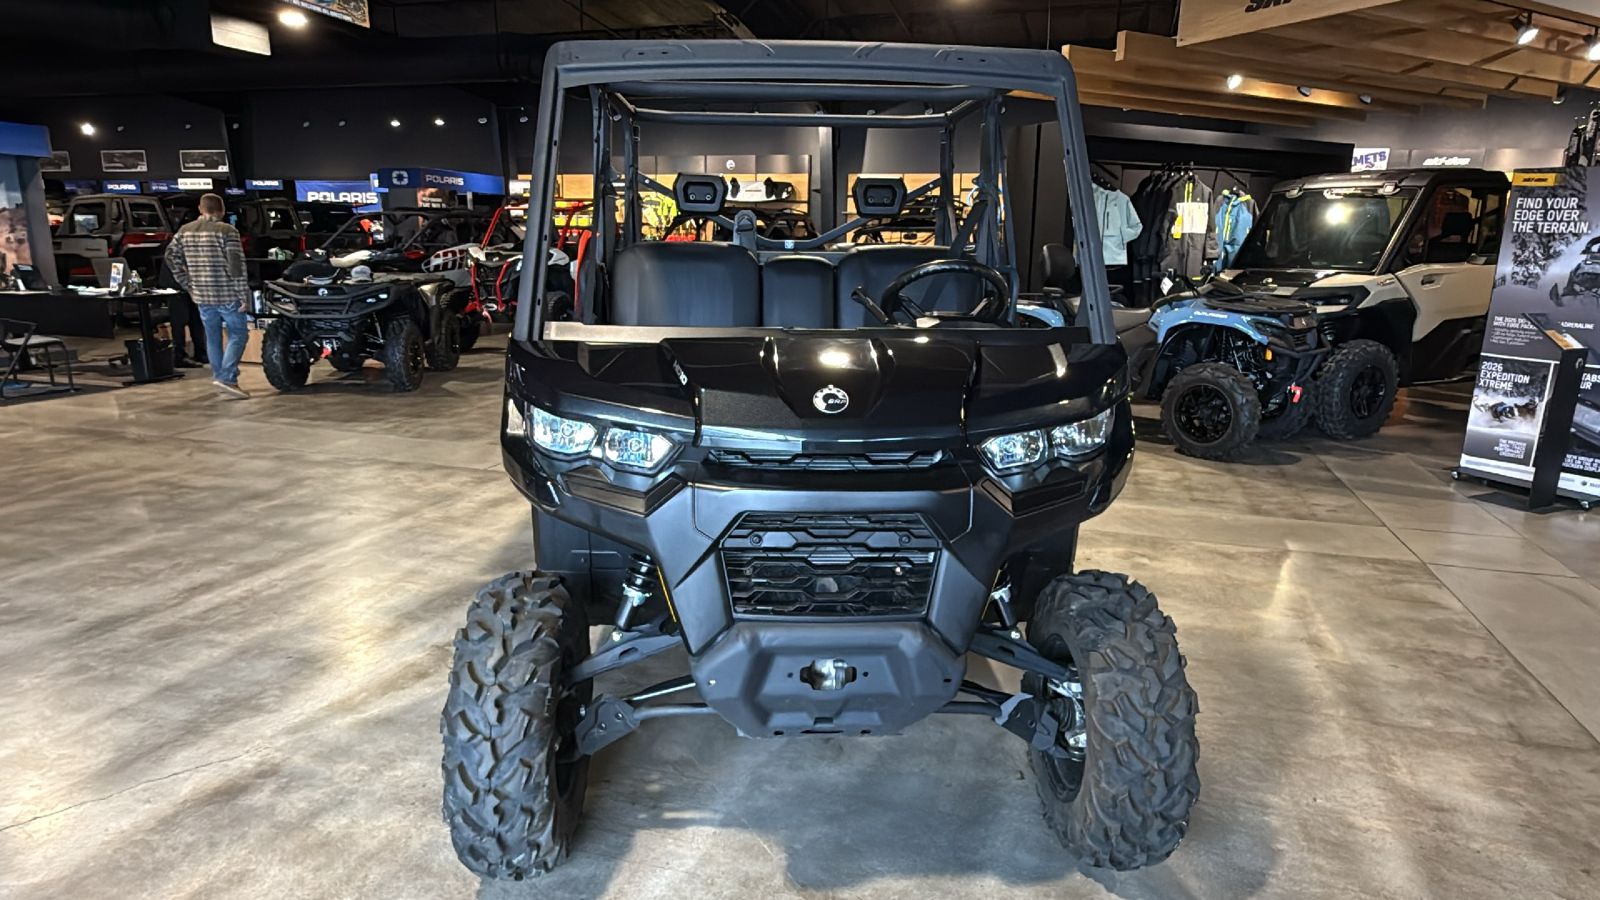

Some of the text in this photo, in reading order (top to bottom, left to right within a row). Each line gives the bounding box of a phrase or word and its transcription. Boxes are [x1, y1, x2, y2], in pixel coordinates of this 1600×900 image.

[1352, 151, 1387, 166] METS
[425, 174, 465, 186] POLARIS
[307, 191, 378, 204] POLARIS
[1516, 197, 1579, 209] FIND YOUR
[1514, 209, 1580, 221] EDGE OVER
[1512, 221, 1592, 234] THE TERRAIN.
[1481, 361, 1503, 372] 2026
[1480, 369, 1530, 384] EXPEDITION
[1478, 377, 1513, 391] XTREME
